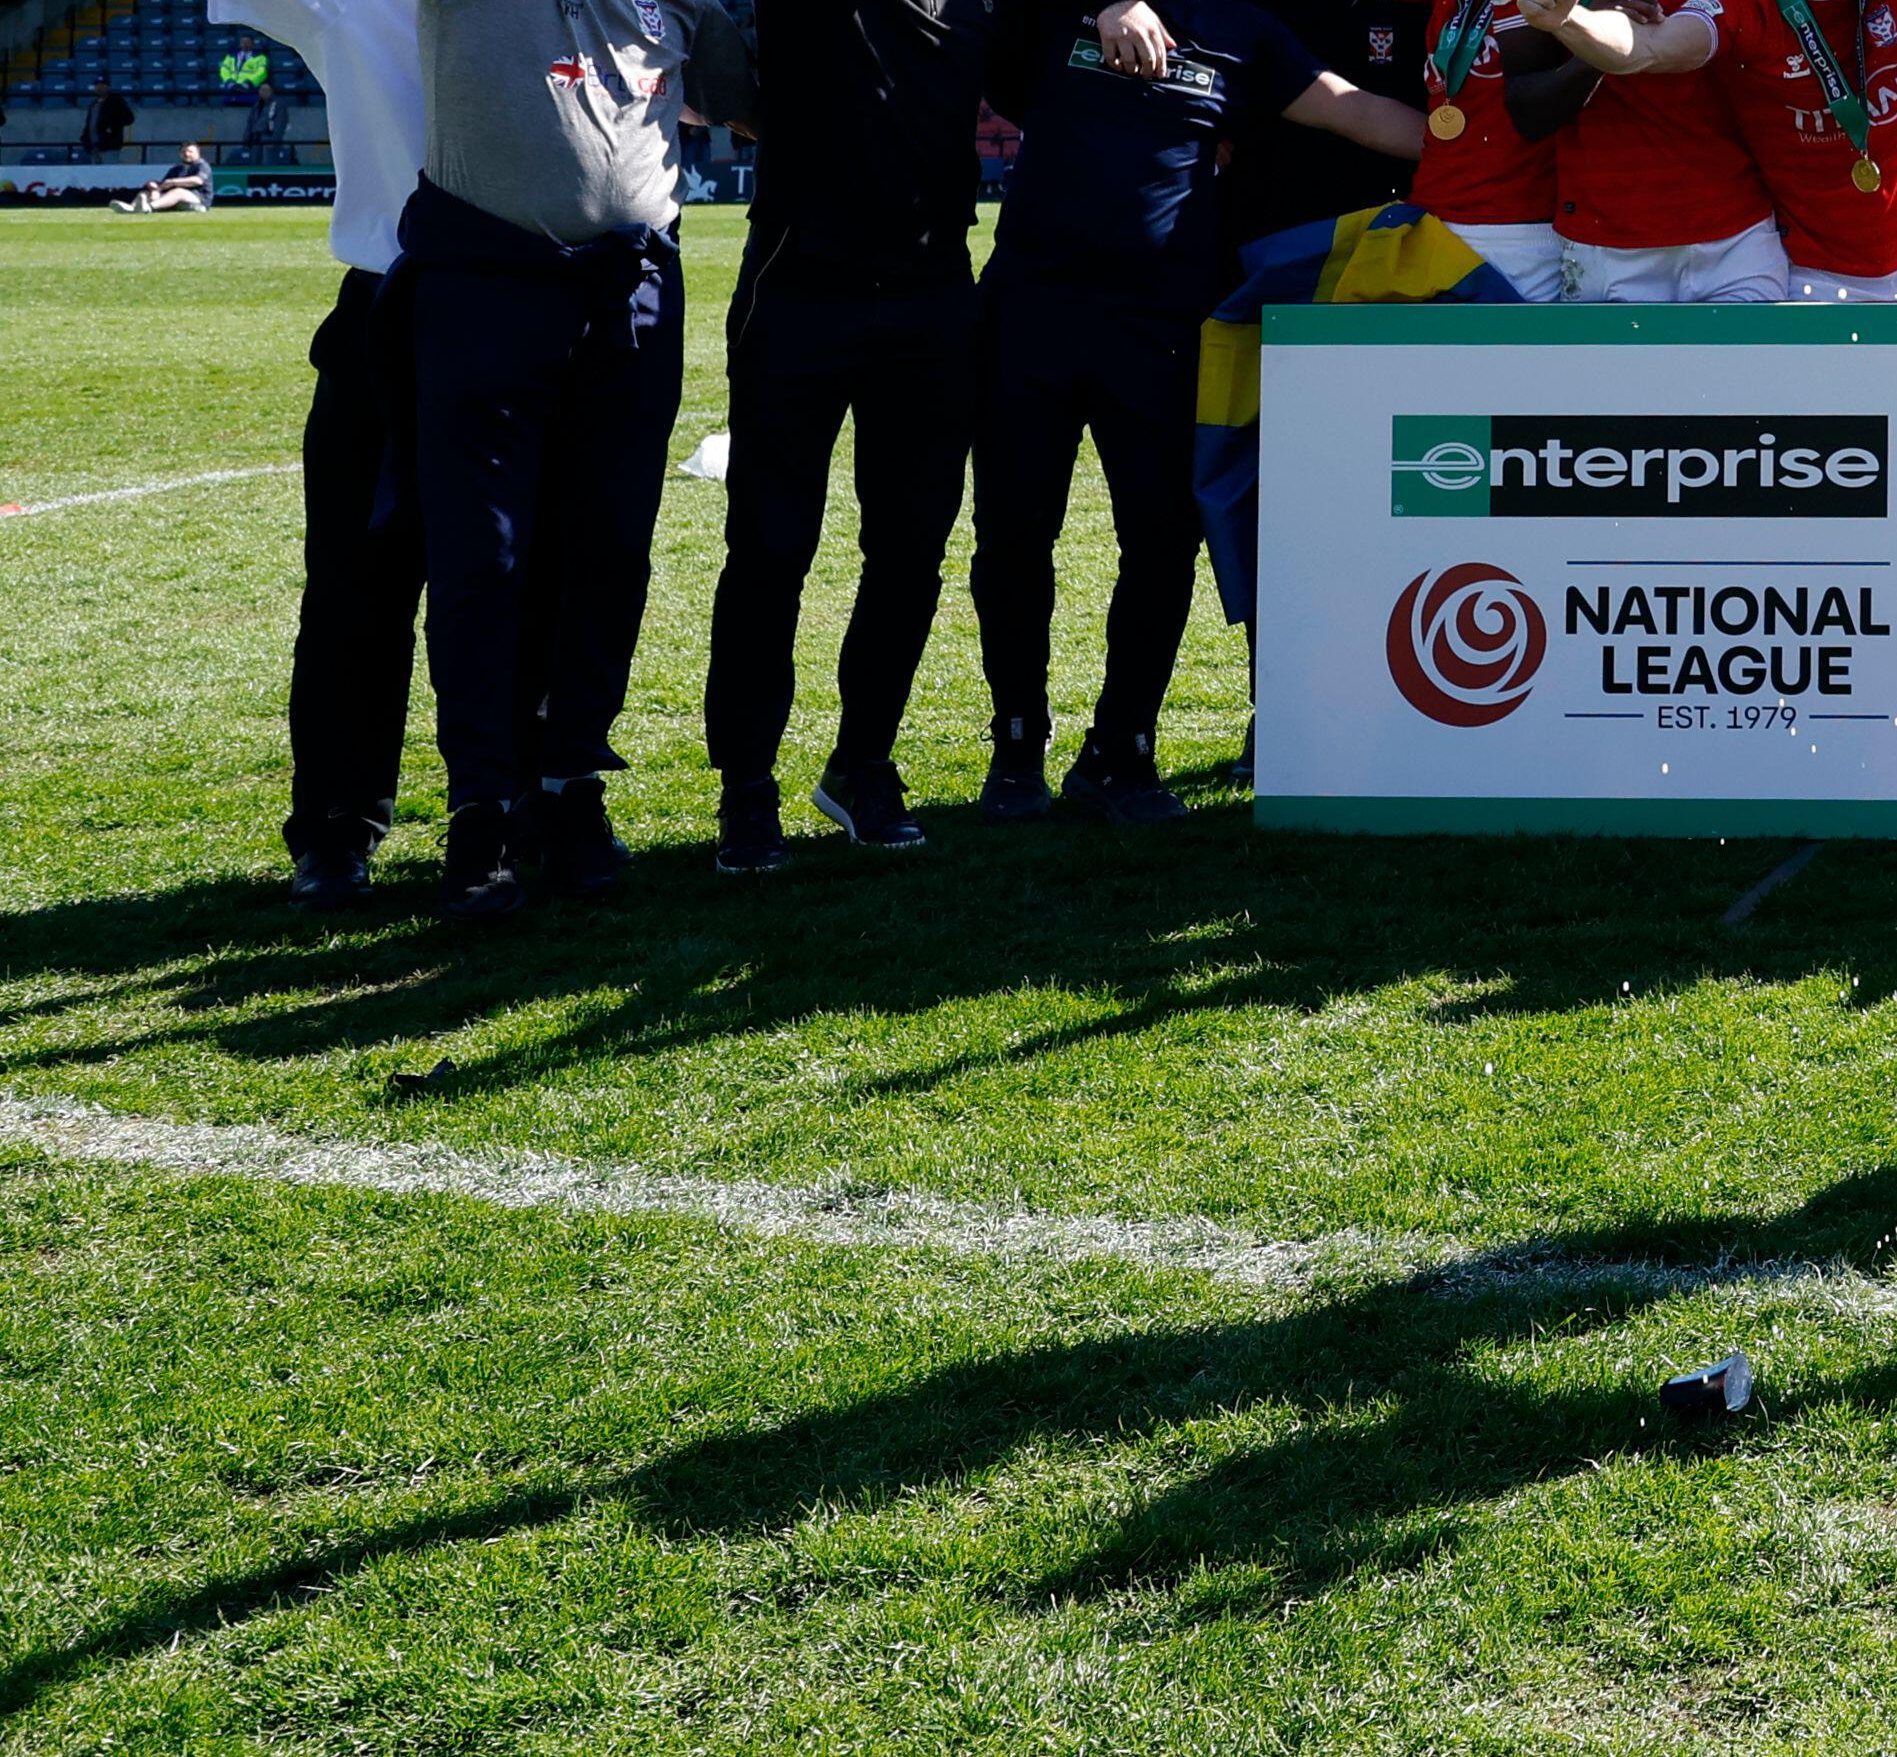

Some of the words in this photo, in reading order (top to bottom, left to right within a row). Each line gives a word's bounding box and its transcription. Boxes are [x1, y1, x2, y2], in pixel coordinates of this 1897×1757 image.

[1790, 8, 1843, 100] enterprise
[1394, 432, 1879, 503] enterprise
[1565, 586, 1891, 637] NATIONAL
[1601, 644, 1853, 696] LEAGUE
[1657, 706, 1717, 730] EST.
[1727, 705, 1798, 731] 1979
